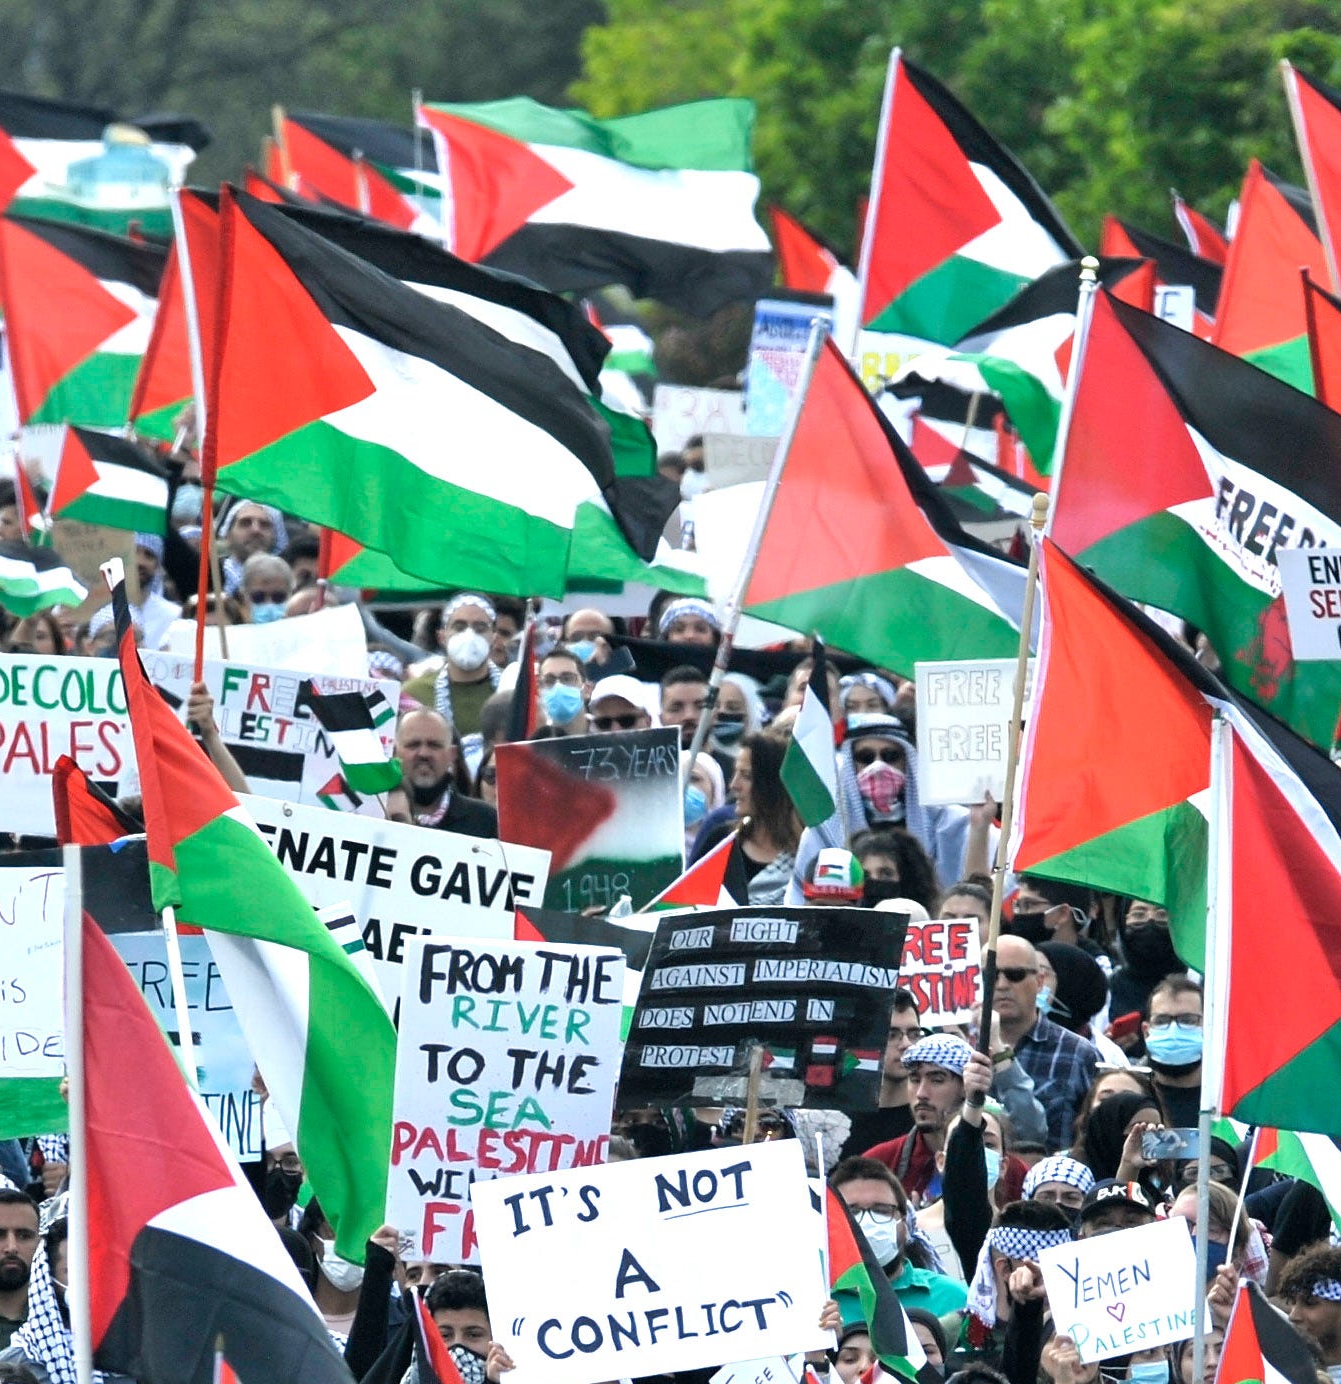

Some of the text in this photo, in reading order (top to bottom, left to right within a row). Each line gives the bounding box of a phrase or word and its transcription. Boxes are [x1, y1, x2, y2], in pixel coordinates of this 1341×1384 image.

[928, 671, 1000, 706] FREE
[930, 726, 1002, 761] FREE
[258, 824, 535, 912] ENATE GAVE
[672, 920, 798, 949] OUR FIGHT
[901, 923, 973, 967] REE
[126, 960, 234, 1010] REE
[419, 943, 622, 1003] FROM THE
[654, 959, 898, 988] AGAINST IMPERIALISM
[453, 996, 590, 1045] RIVER
[642, 1002, 833, 1028] DOES NOT END IN
[420, 1043, 600, 1094] TO THE
[642, 1046, 734, 1068] PROTEST
[447, 1088, 552, 1130] SEA
[504, 1184, 602, 1238] IT'S
[654, 1160, 752, 1213] NOT
[615, 1247, 661, 1299] A
[1057, 1257, 1152, 1309] YEMEN
